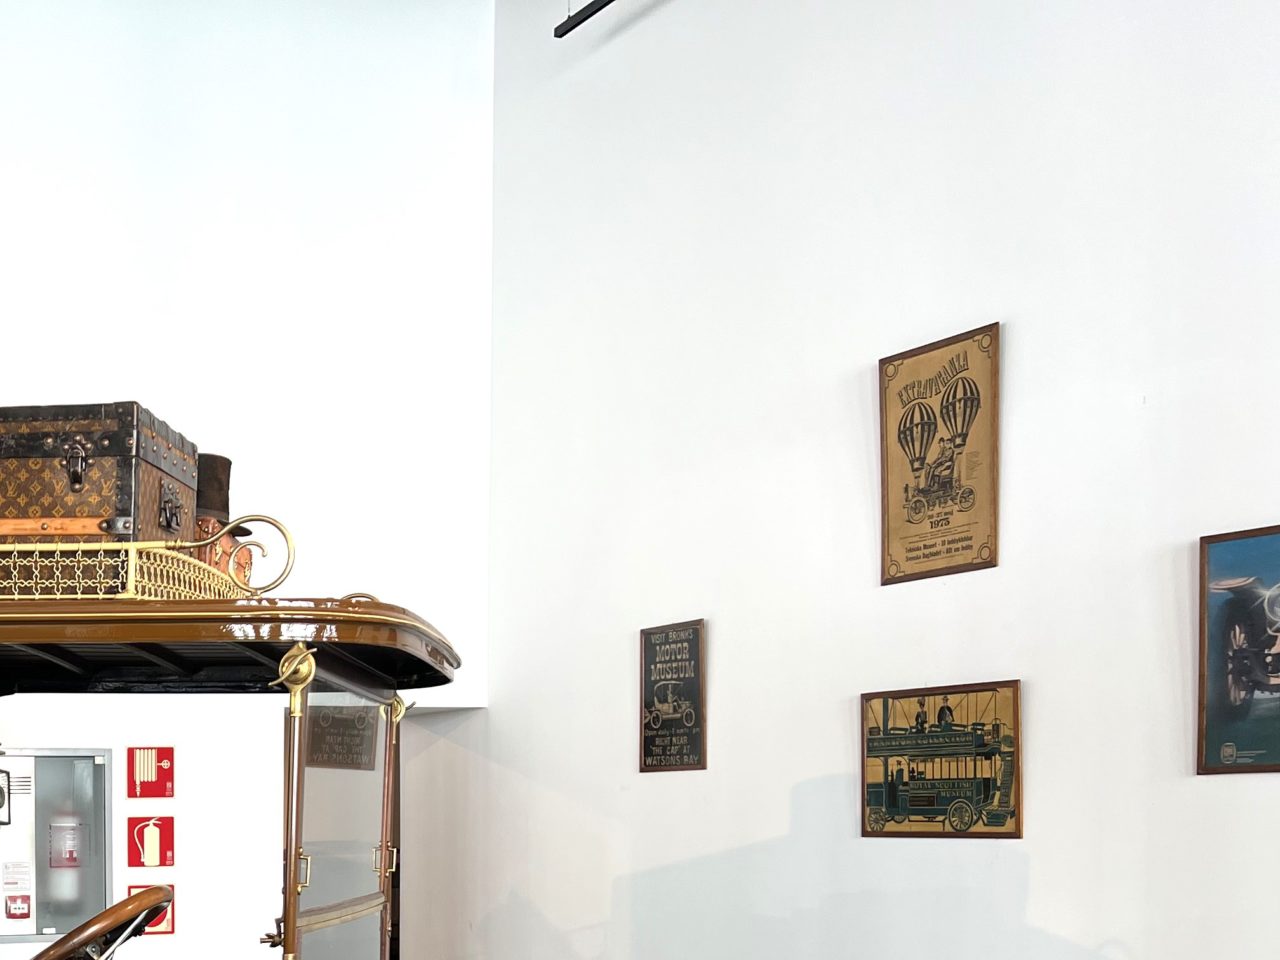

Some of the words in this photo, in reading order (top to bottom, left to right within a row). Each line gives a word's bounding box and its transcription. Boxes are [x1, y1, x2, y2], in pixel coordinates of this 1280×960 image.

[897, 351, 969, 409] EXTRAVAGANZA
[656, 642, 689, 662] MOTOR
[651, 660, 695, 680] MUSEUM
[672, 736, 688, 745] NEAR
[645, 756, 681, 766] WATSONS
[683, 754, 699, 764] BAY
